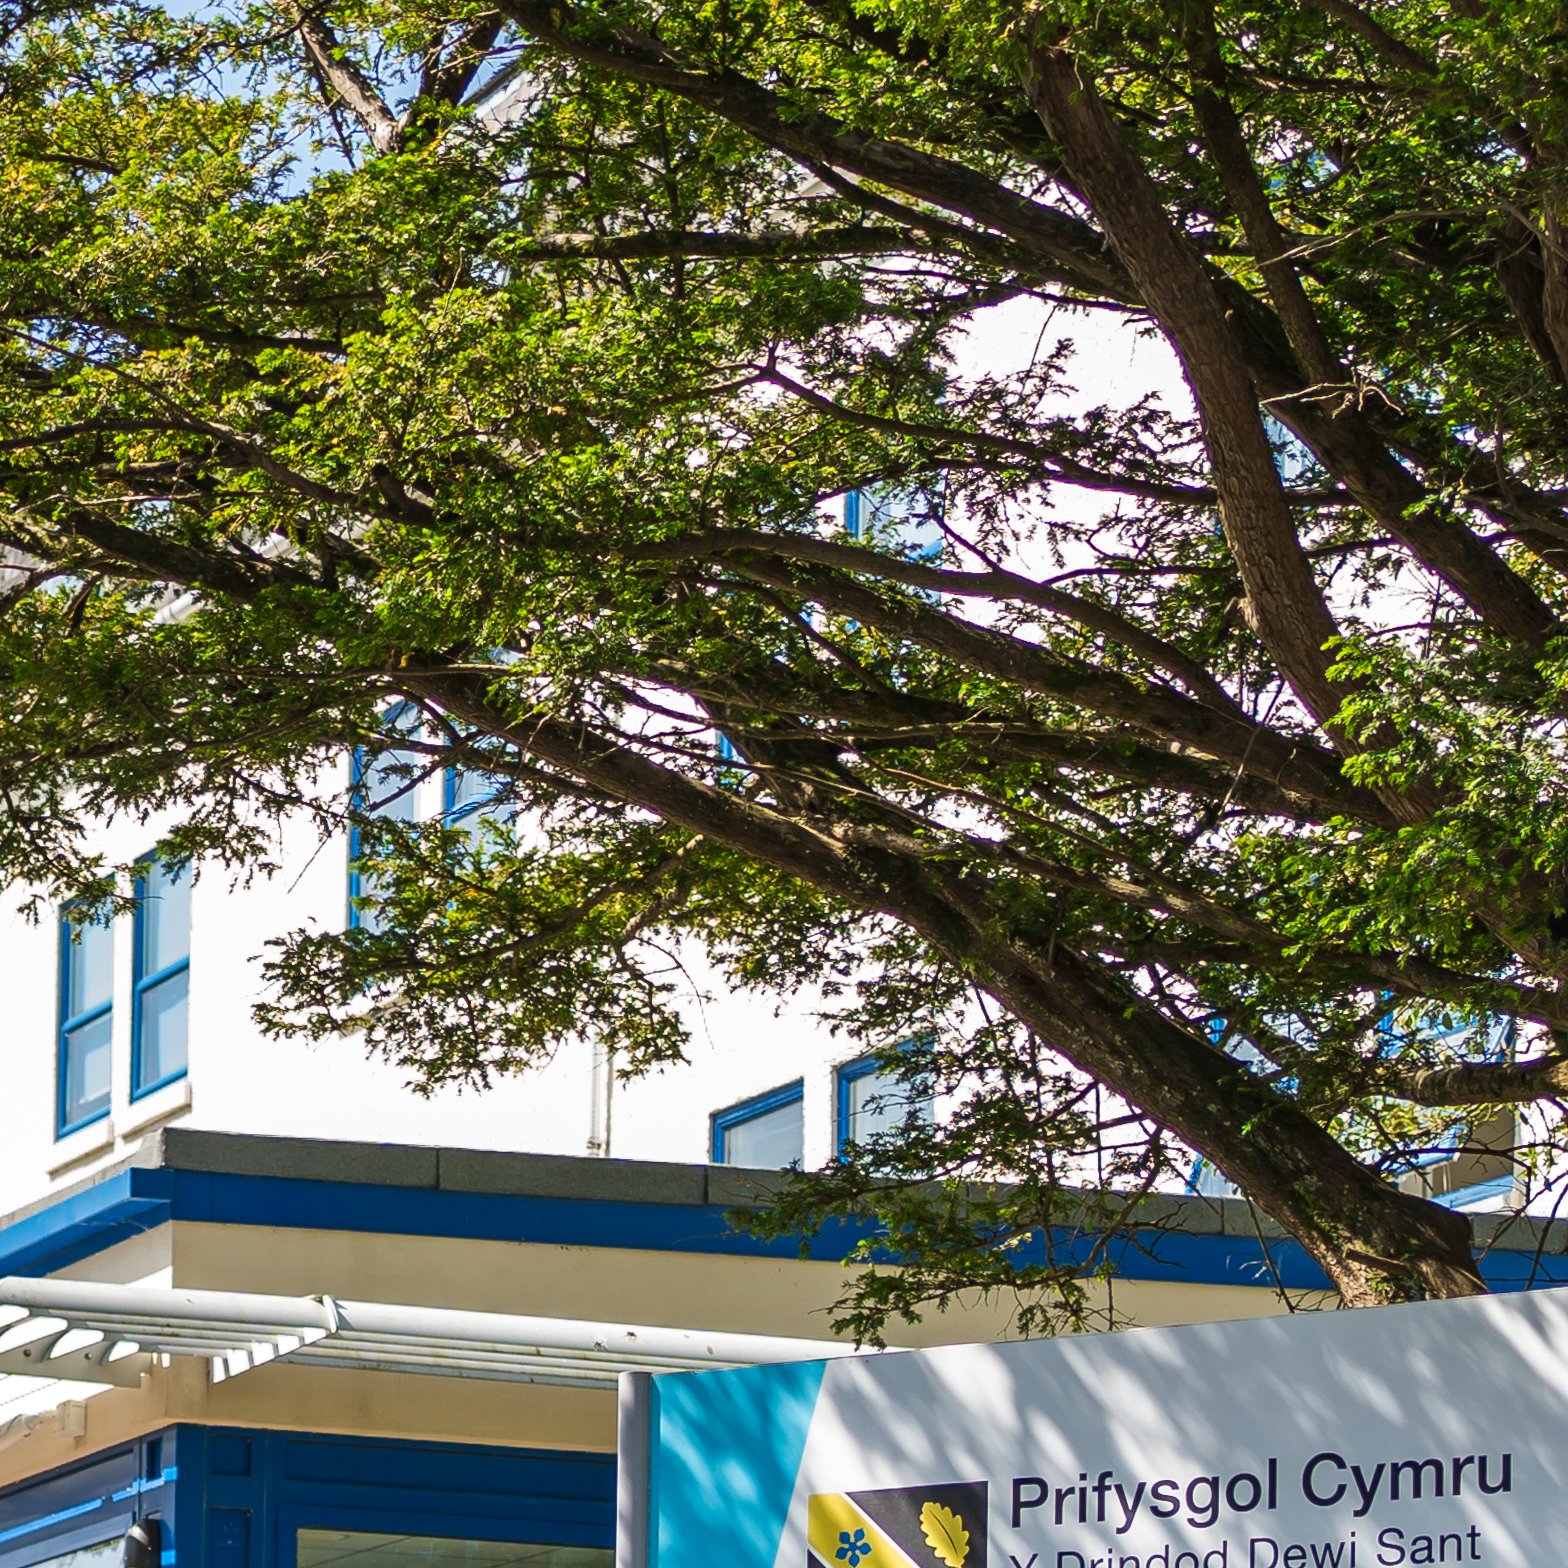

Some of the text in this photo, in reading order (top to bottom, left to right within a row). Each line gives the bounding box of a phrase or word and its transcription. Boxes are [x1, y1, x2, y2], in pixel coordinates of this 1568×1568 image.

[1010, 1452, 1514, 1535] Prifysgol Cymru
[1376, 1524, 1483, 1567] Sant
